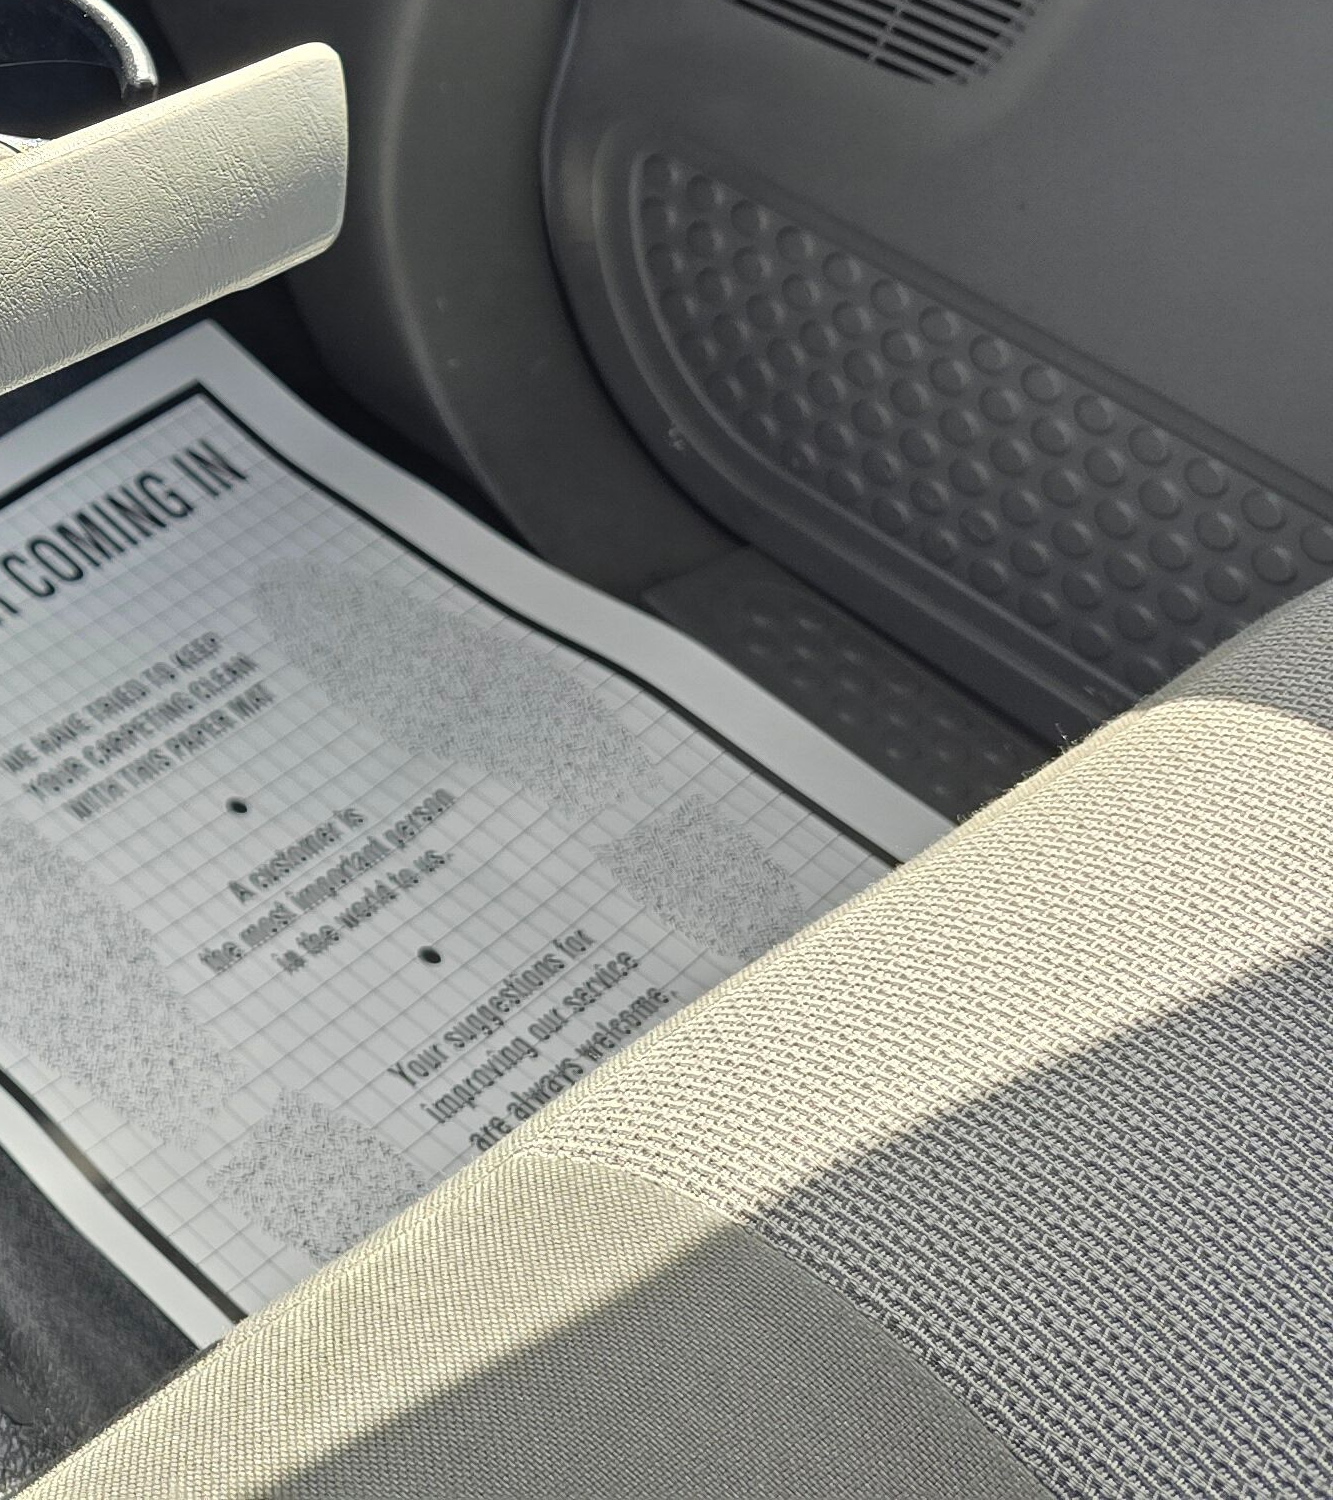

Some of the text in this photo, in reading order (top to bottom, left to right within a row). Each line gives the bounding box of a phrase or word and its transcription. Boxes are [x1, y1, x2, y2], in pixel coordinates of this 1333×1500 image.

[169, 437, 248, 501] IN
[23, 653, 259, 801] YOUR CARPETING CLEAN
[31, 712, 91, 756] HAVE
[83, 679, 151, 723] TRIED
[140, 662, 177, 689] TO
[169, 631, 221, 671] KEEP
[63, 682, 276, 821] WITH THIS PAPER MAT
[199, 789, 455, 973] the most important person
[229, 808, 366, 904] A customer is
[271, 951, 307, 973] in
[297, 925, 339, 954] the
[335, 880, 397, 929] world
[387, 868, 419, 890] to
[388, 930, 595, 1087] Your suggestions for
[421, 952, 638, 1123] improving our service
[469, 1116, 512, 1150] are
[507, 1058, 583, 1121] always
